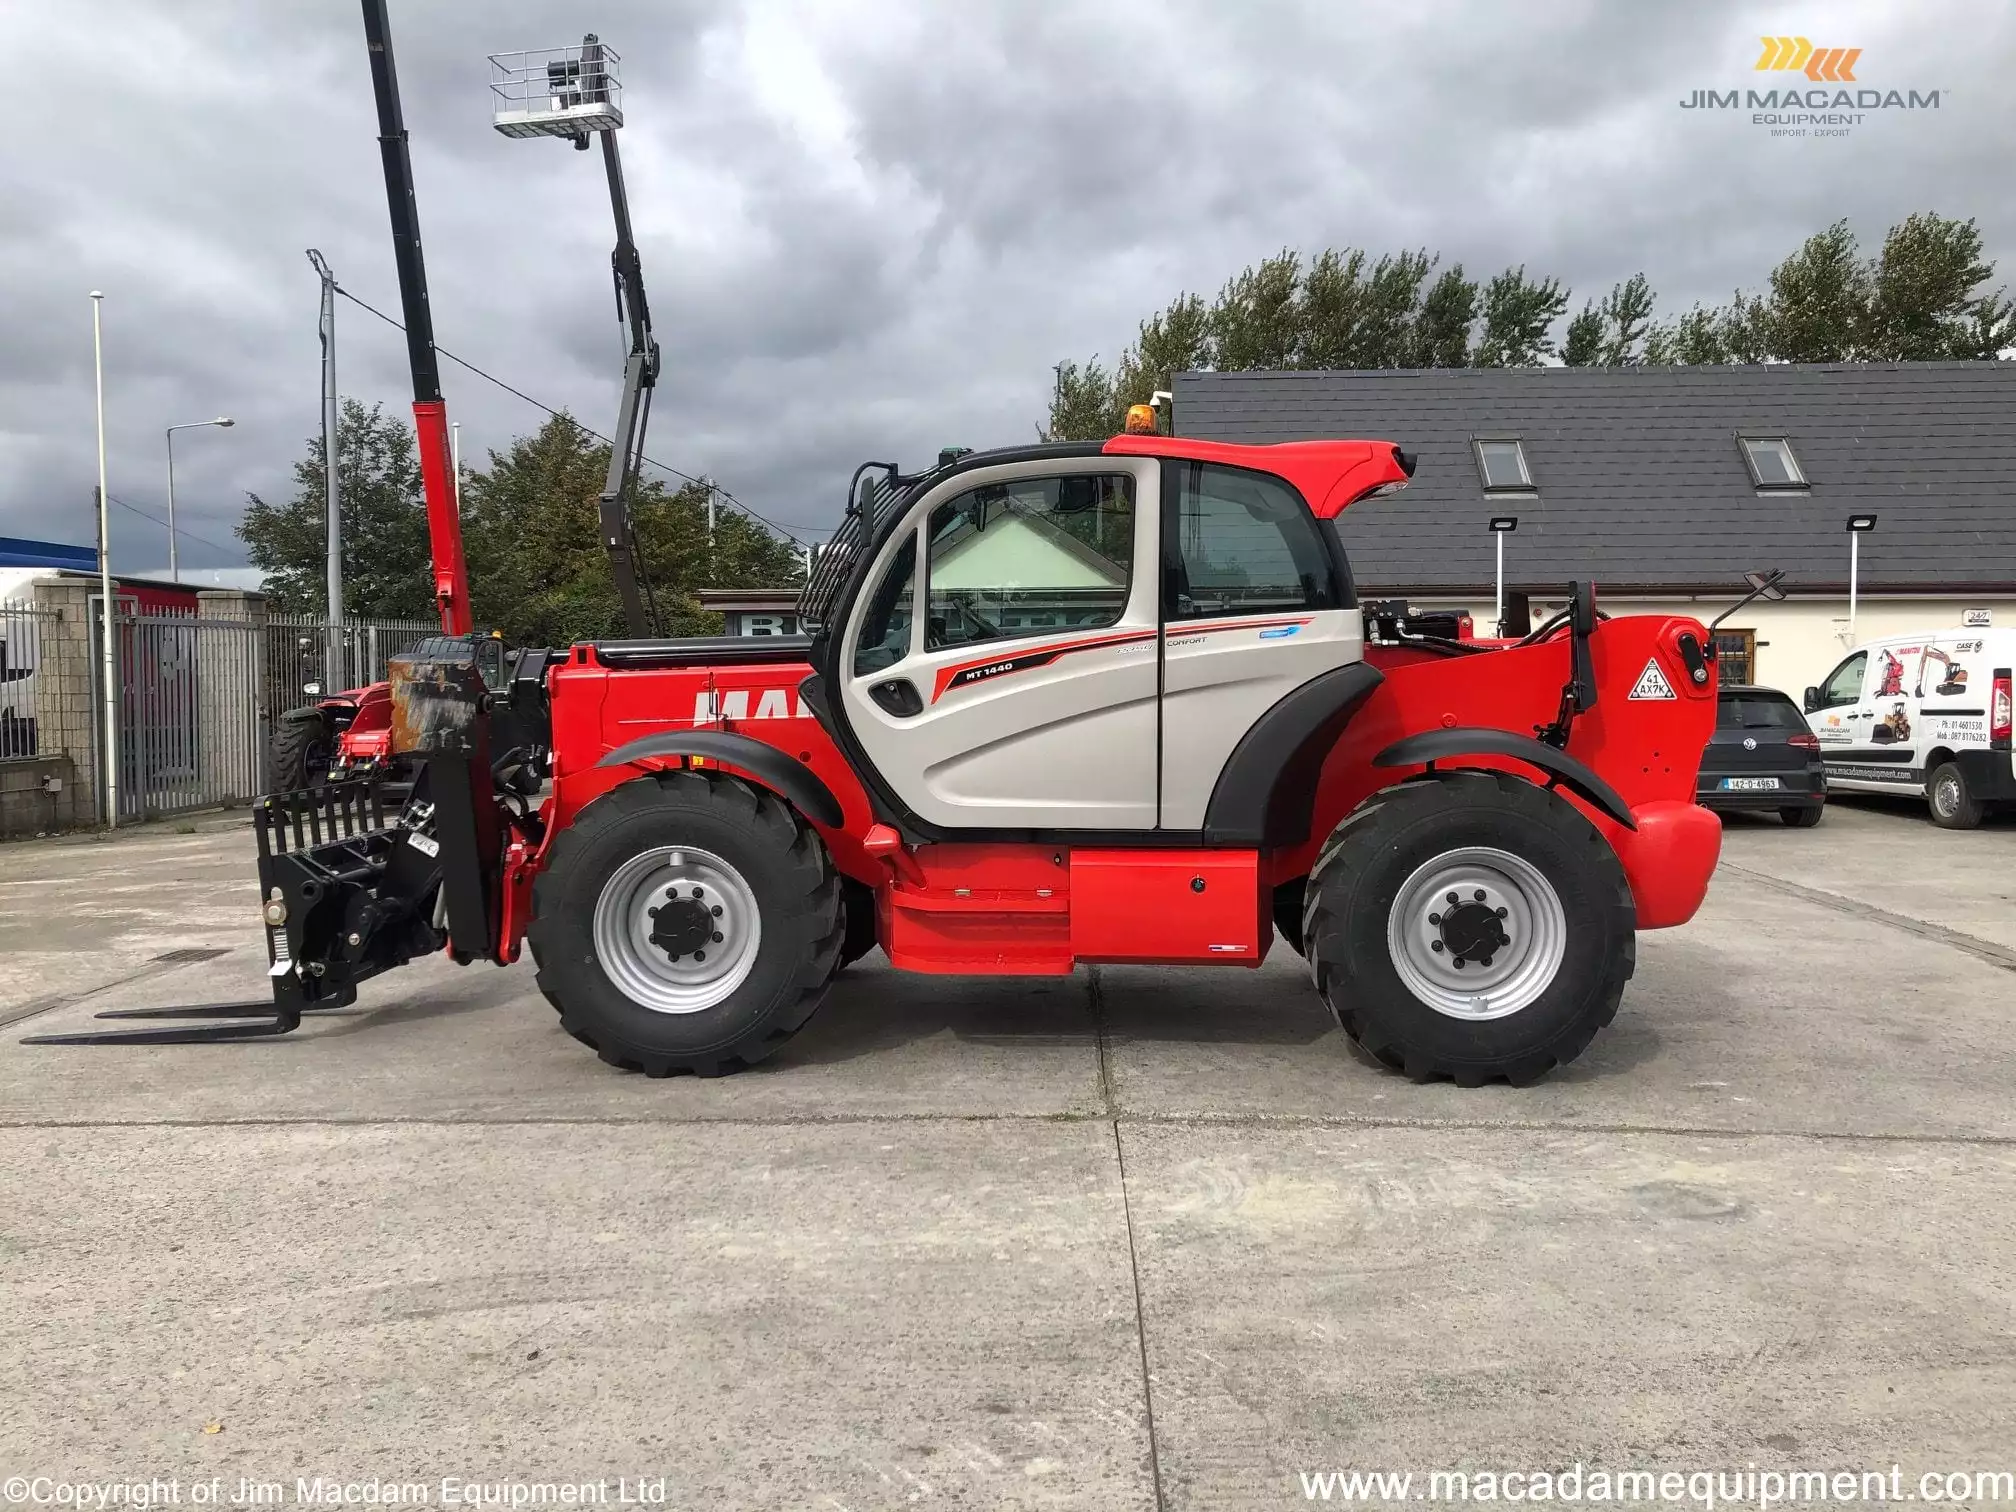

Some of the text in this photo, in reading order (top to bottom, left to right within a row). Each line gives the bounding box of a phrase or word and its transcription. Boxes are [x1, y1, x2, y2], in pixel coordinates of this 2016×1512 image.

[1166, 636, 1208, 647] COMFORT
[1956, 642, 1974, 650] CASE
[966, 663, 1013, 680] MT 1440
[1647, 674, 1659, 684] 41
[1640, 684, 1666, 695] AX7K
